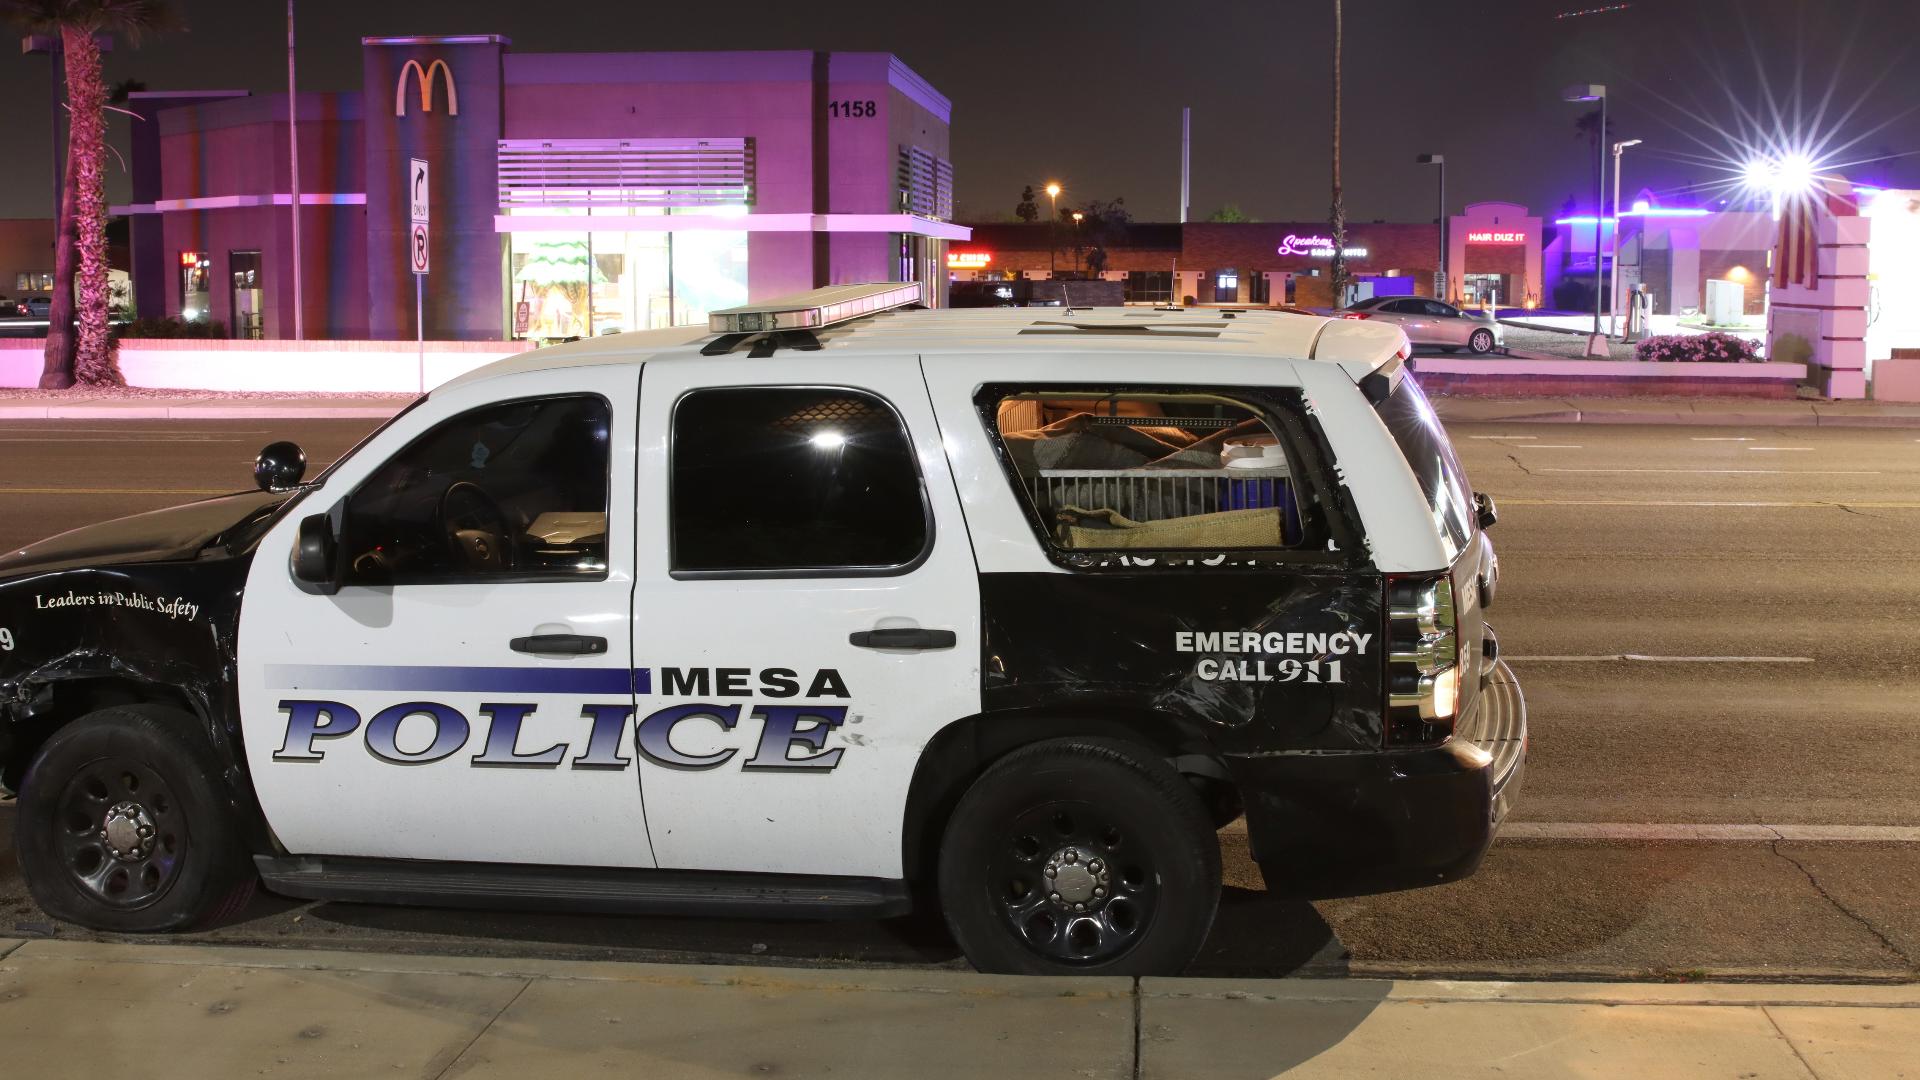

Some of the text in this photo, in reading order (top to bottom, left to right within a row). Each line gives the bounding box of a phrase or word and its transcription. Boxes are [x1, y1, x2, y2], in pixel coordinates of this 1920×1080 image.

[829, 100, 876, 118] 1158
[413, 204, 427, 217] ONLY
[1469, 233, 1525, 241] HAIR DUZ IT
[35, 591, 199, 622] Leaders in Public Safety
[1175, 631, 1373, 655] EMERGENCY
[661, 667, 852, 699] MESA
[1197, 659, 1346, 684] CALL 911
[272, 699, 850, 773] POLICE
